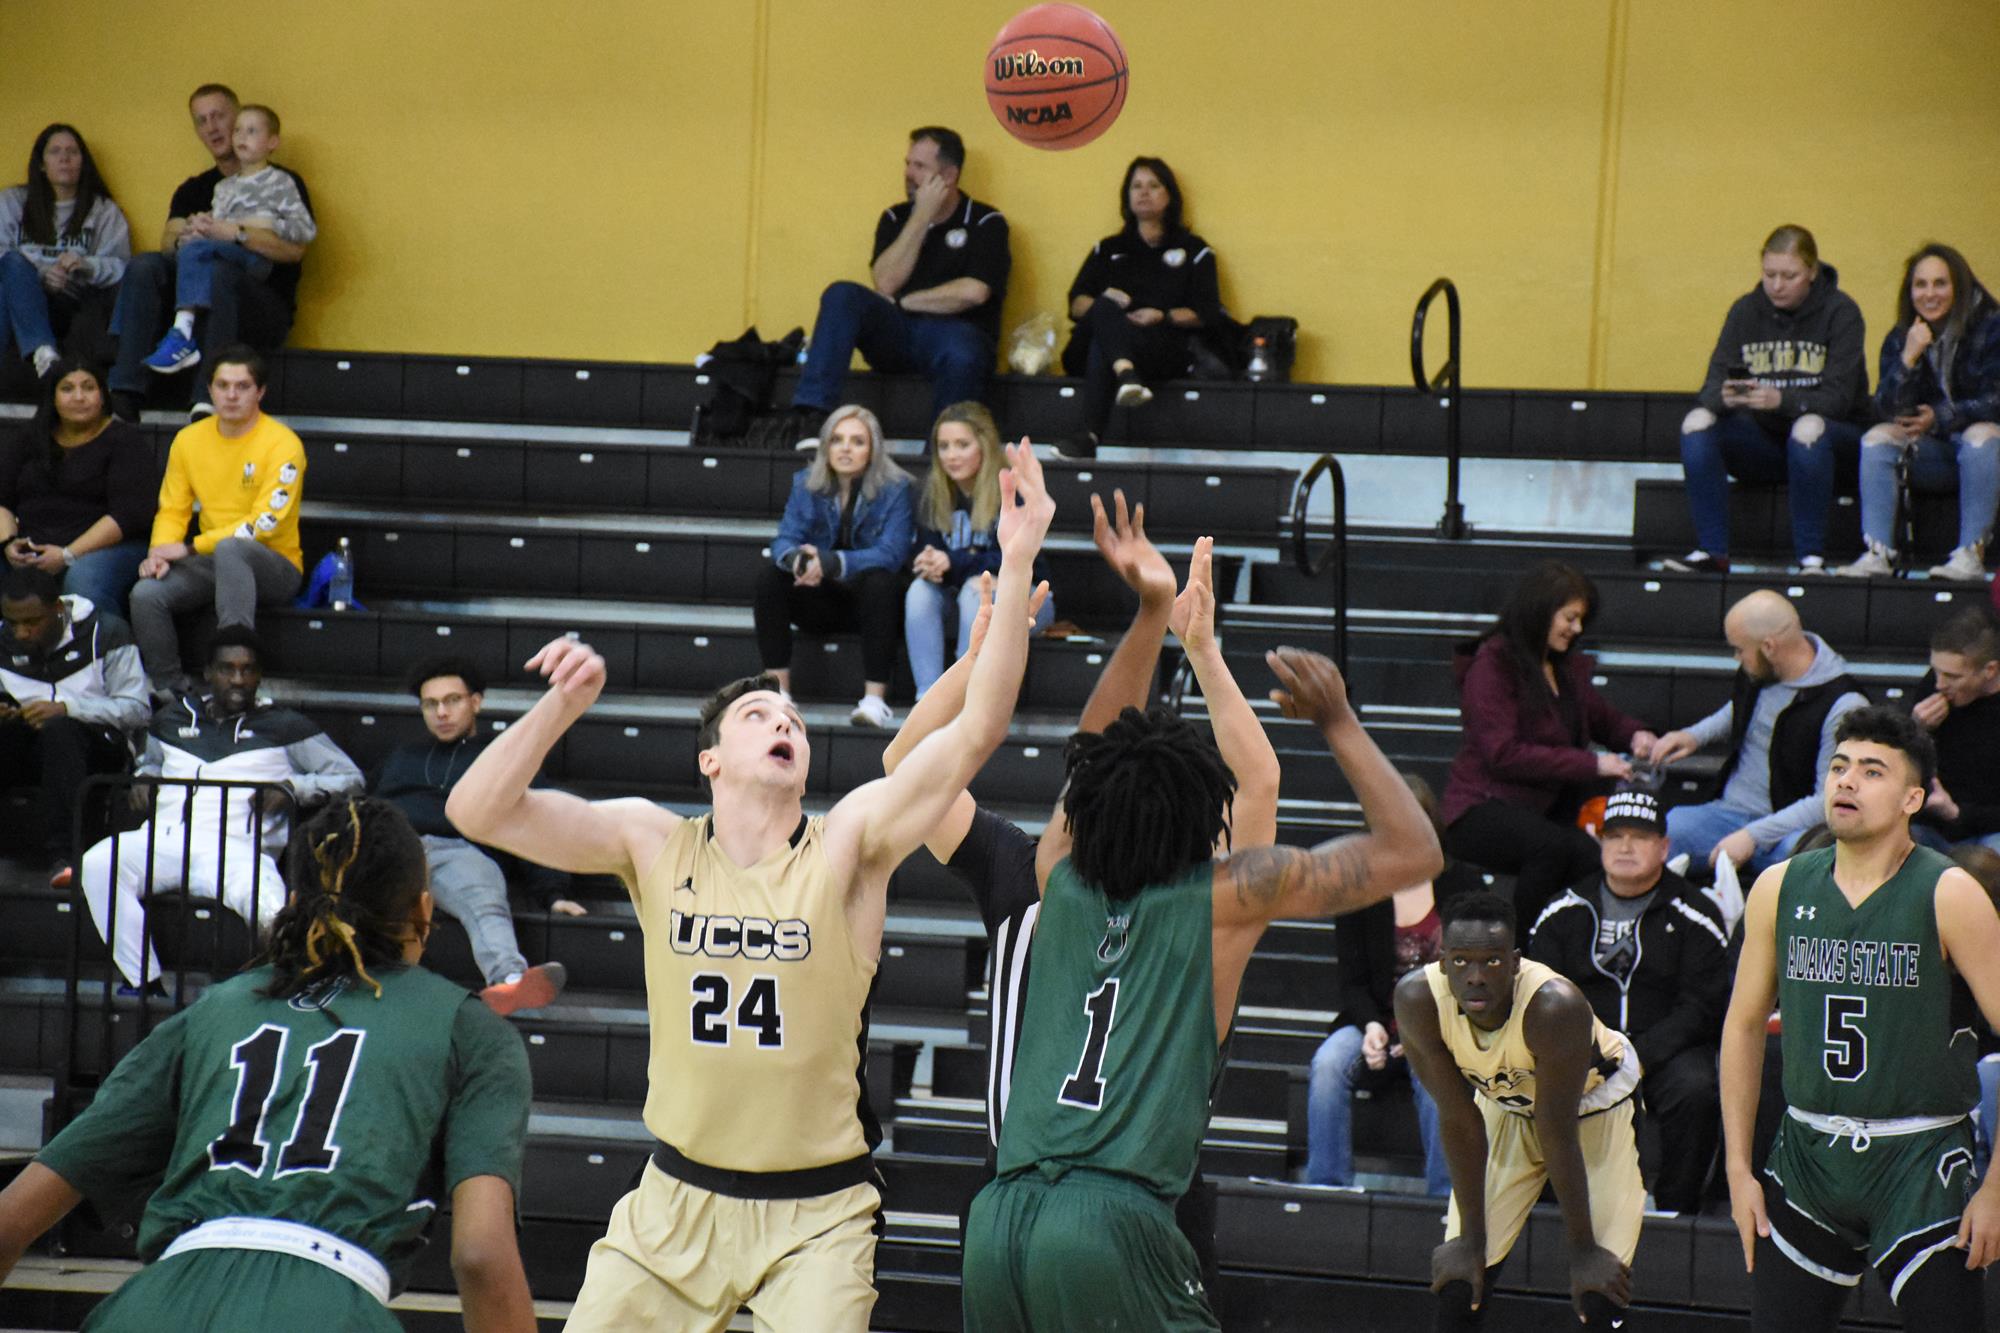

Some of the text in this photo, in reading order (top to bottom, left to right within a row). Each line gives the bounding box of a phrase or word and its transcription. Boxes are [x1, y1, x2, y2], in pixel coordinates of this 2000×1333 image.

[994, 49, 1084, 81] Wilson
[1006, 101, 1073, 125] NCAA
[670, 909, 811, 961] UCCS
[1787, 936, 1920, 987] ADAMS STATE
[690, 971, 784, 1050] 24
[1824, 994, 1867, 1081] 5
[1057, 977, 1120, 1111] 1
[207, 1023, 366, 1180] 11
